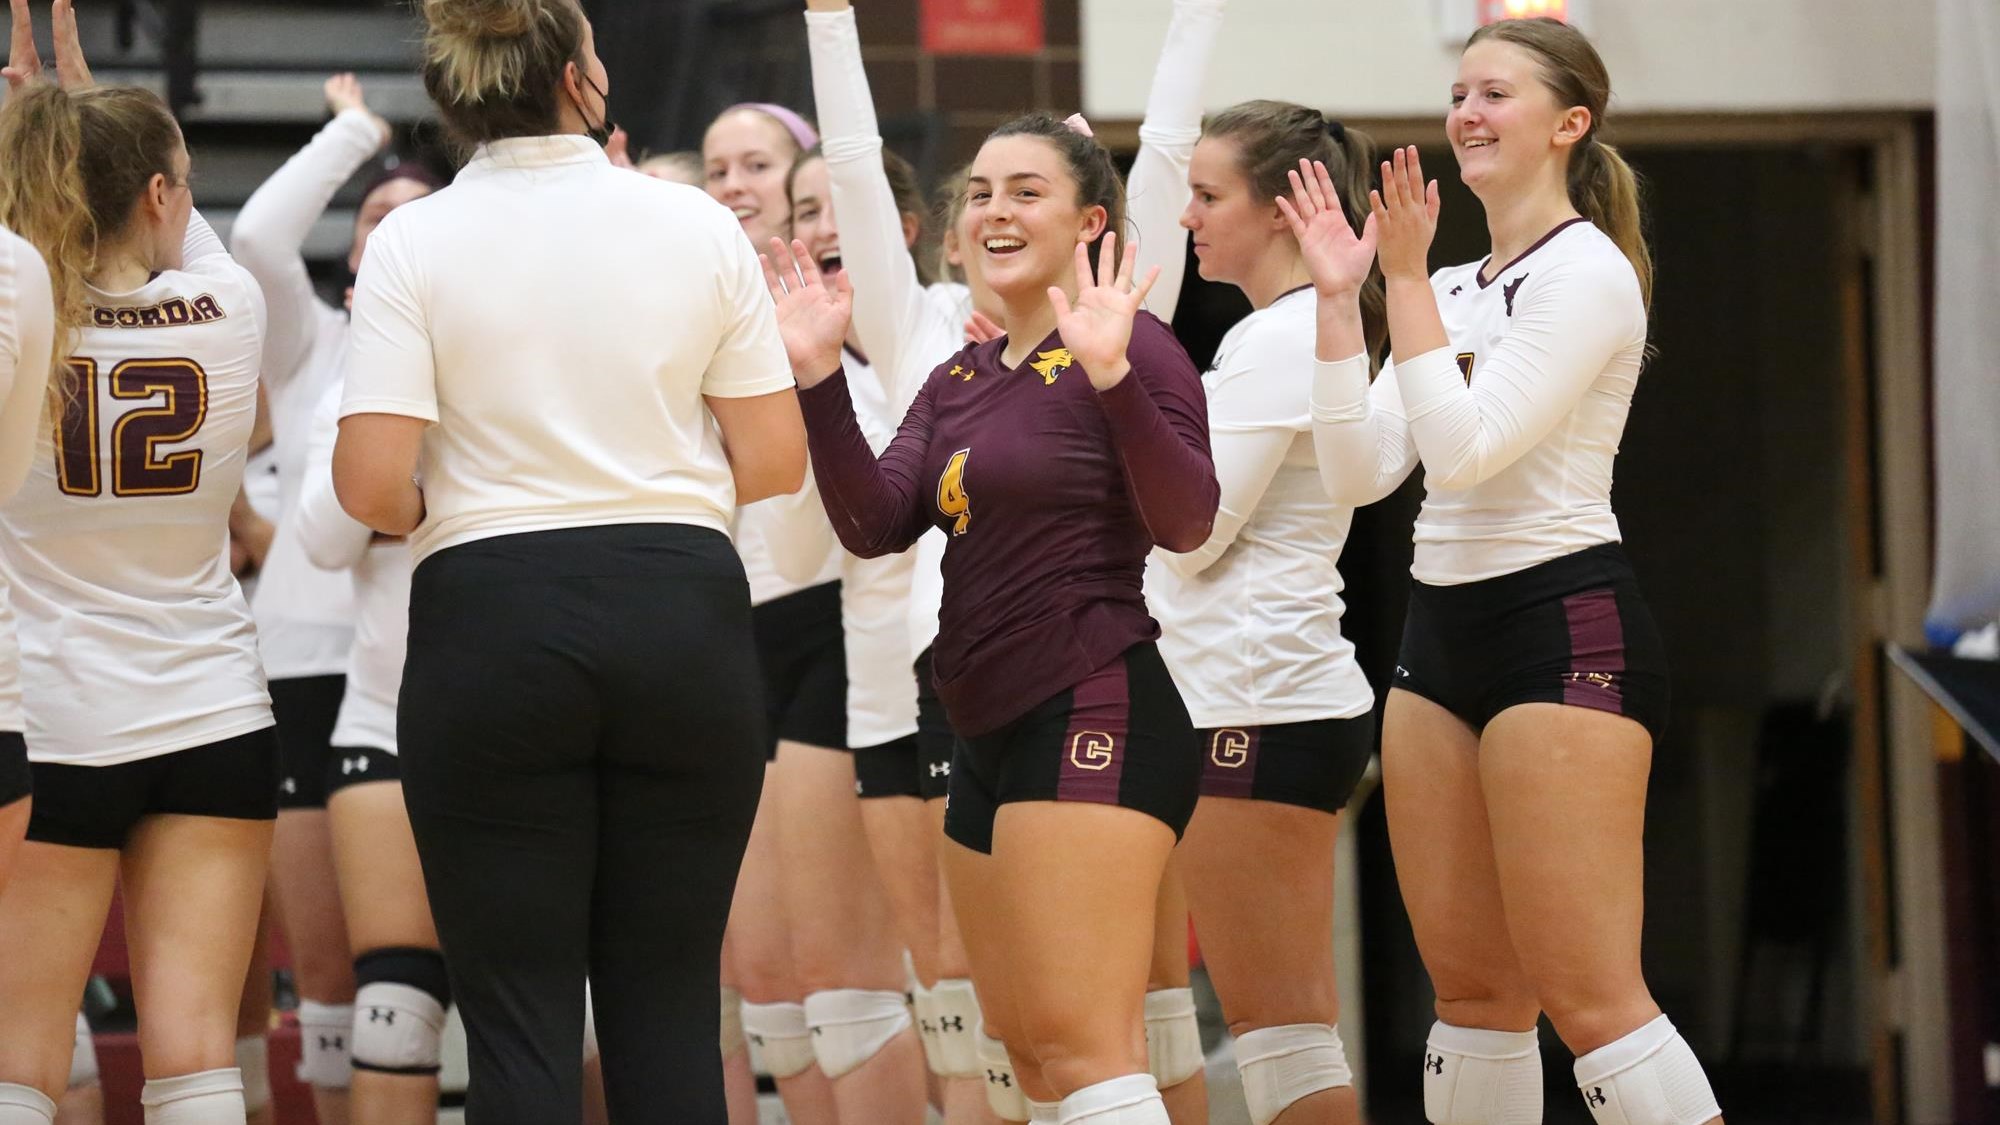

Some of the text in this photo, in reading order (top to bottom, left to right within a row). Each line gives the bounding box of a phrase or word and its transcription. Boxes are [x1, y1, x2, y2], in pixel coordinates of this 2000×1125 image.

[55, 357, 208, 497] 12
[937, 447, 971, 537] 4
[1071, 730, 1113, 770] C
[1211, 728, 1249, 768] C
